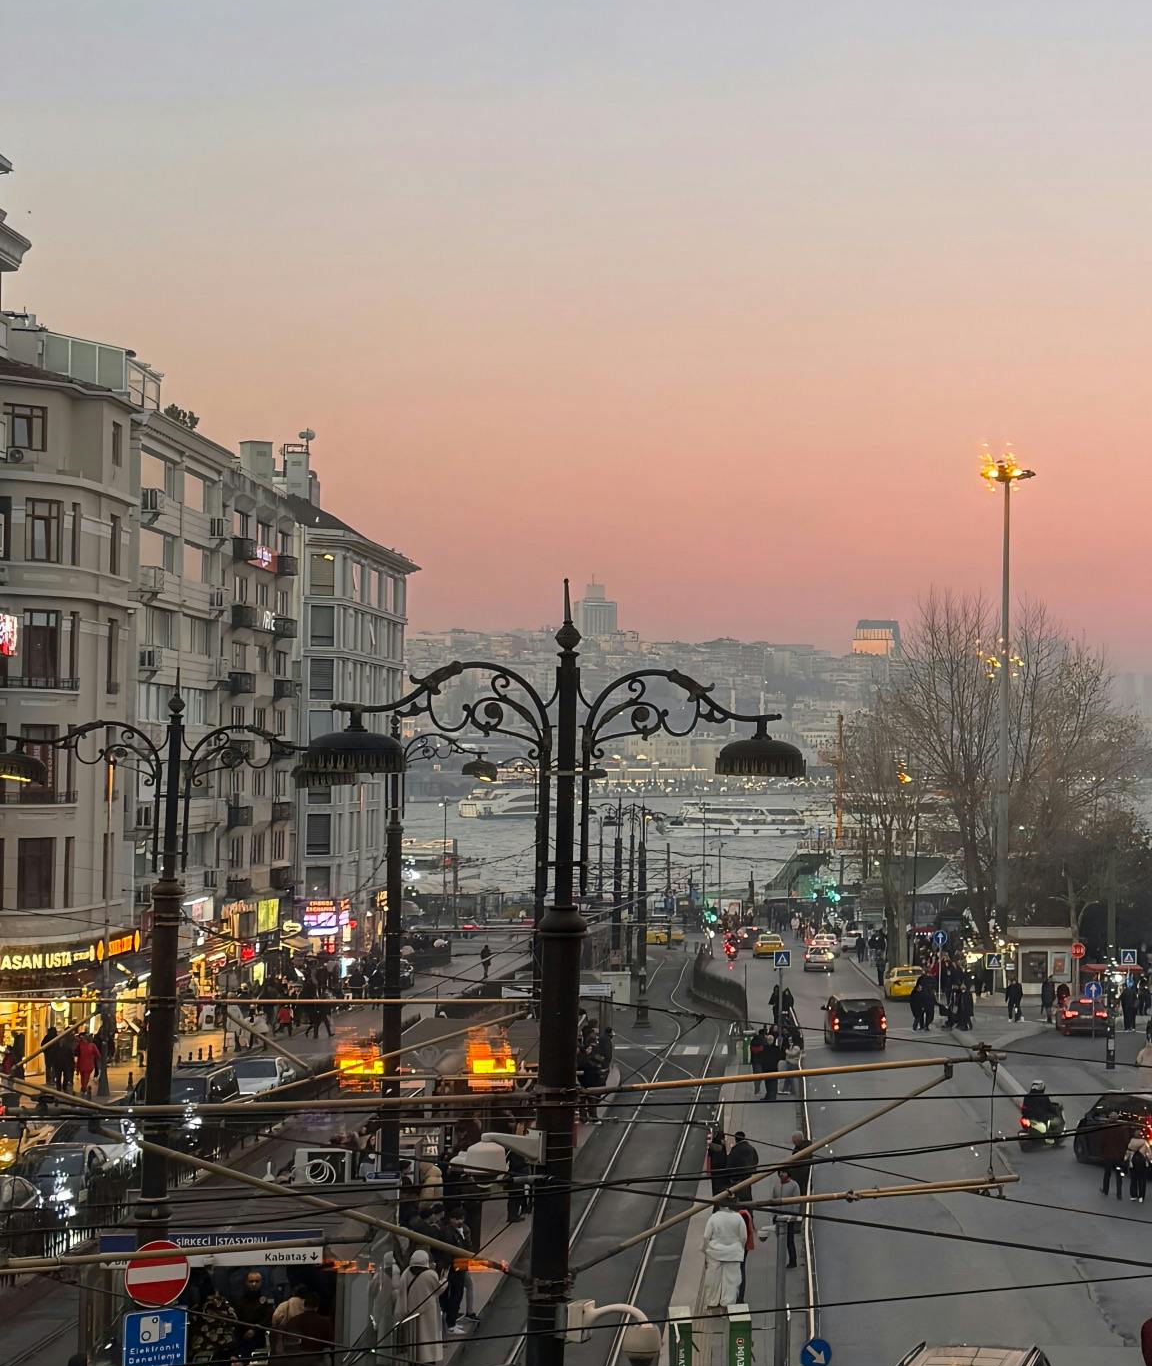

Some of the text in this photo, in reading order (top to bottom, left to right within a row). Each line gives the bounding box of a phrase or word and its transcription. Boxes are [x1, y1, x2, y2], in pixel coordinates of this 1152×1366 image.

[0, 953, 43, 971] ASAN
[45, 950, 72, 969] USTA
[264, 1252, 308, 1263] Kabataş
[129, 1343, 180, 1355] Elektronik
